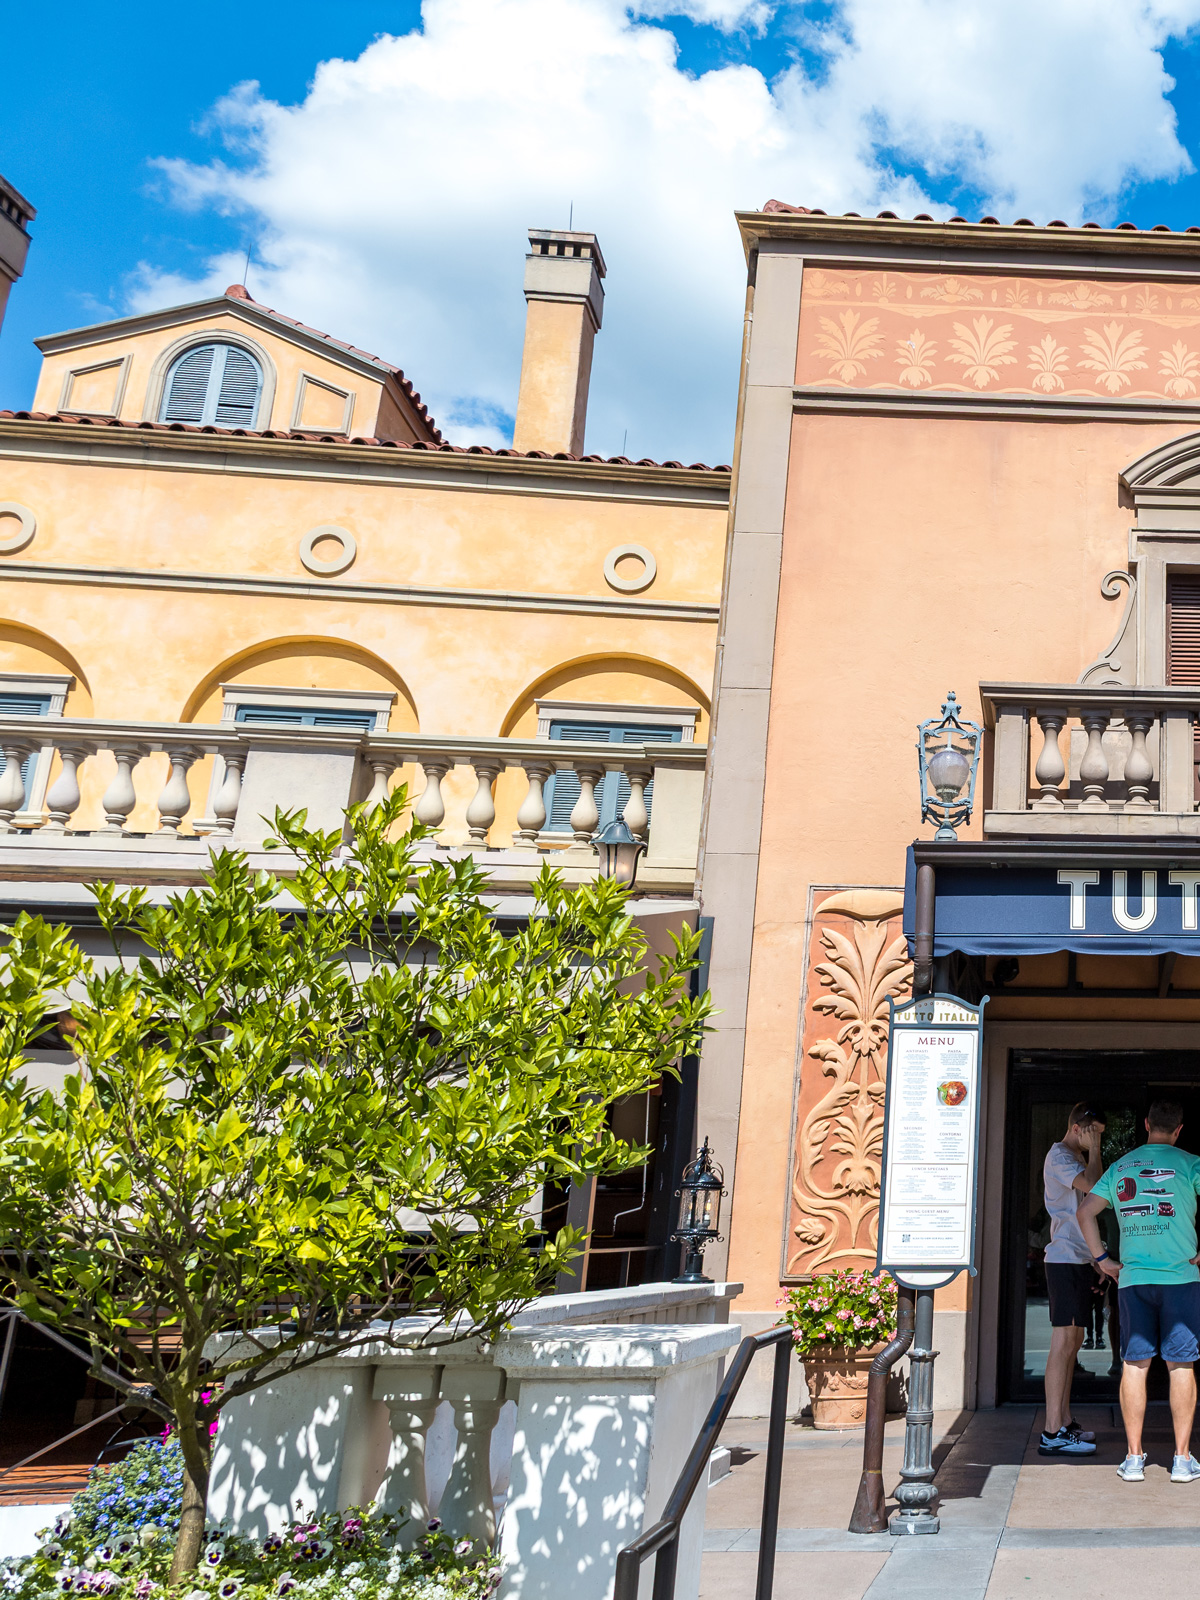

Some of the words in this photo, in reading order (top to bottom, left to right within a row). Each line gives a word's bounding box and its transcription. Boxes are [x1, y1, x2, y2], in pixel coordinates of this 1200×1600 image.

[896, 1012, 934, 1021] TUTTO
[939, 1013, 977, 1022] ITALIA
[917, 1037, 955, 1046] MENU
[1142, 1222, 1170, 1232] magical
